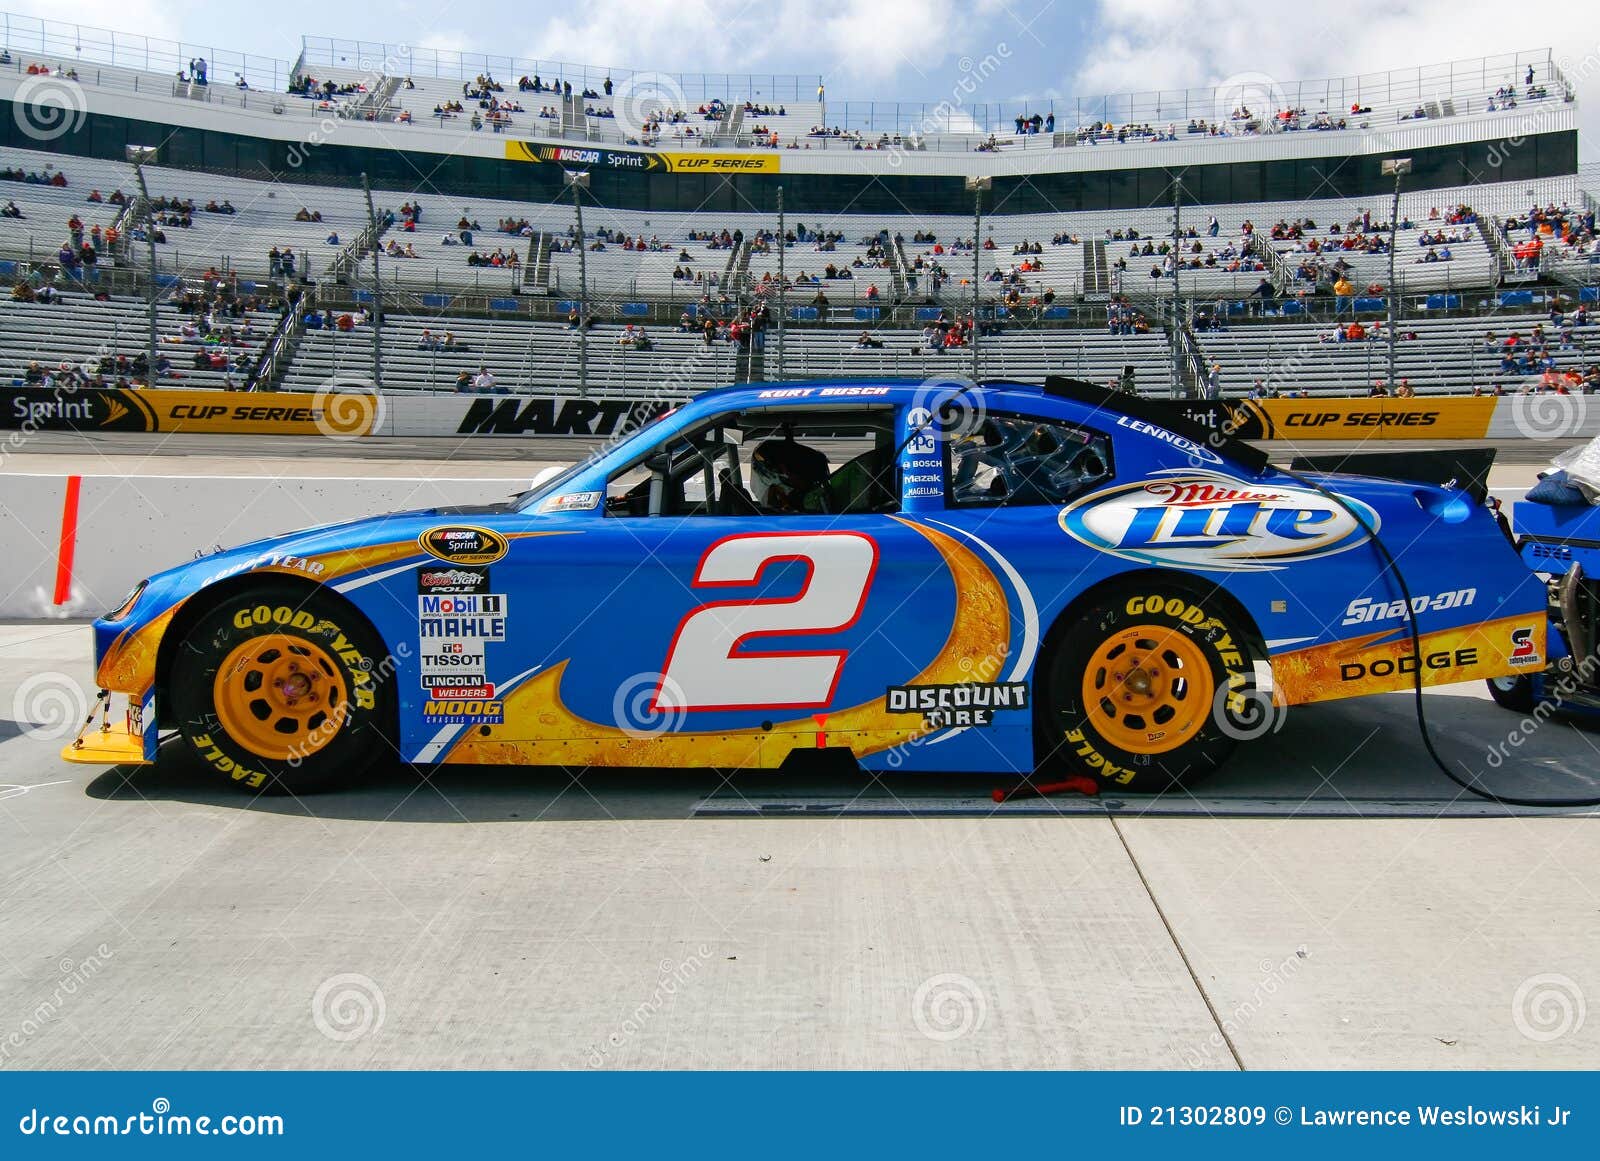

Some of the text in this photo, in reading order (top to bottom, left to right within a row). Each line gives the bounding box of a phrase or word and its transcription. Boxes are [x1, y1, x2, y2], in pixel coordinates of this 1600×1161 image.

[557, 149, 765, 168] NASCAR Sprint CUP SERIES
[758, 386, 892, 399] KURT BUSCH
[13, 396, 327, 423] Sprint CUP SERIES
[1285, 412, 1341, 427] CUP
[1343, 412, 1441, 426] SERIES
[907, 436, 934, 451] PPG
[1117, 416, 1203, 456] LENNOX
[912, 460, 943, 468] BOSCH
[904, 474, 941, 484] Mazak
[908, 487, 939, 496] MAGELLAN
[1144, 482, 1292, 504] Miller
[1111, 502, 1338, 549] Lite
[445, 531, 475, 540] NASCAR
[448, 540, 479, 551] Sprint
[452, 575, 485, 585] LIGHT
[422, 596, 477, 613] Mobil
[1341, 588, 1477, 626] Snap-on
[420, 618, 504, 637] MAHLE
[648, 530, 881, 713] 2
[233, 605, 376, 710] GOODYEAR
[422, 654, 483, 666] TISSOT
[1125, 594, 1247, 715] GOODYEAR
[1341, 648, 1478, 681] DODGE
[425, 677, 481, 686] LINCOLN
[438, 689, 487, 697] WELDERS
[889, 685, 1026, 710] DISCOUNT
[423, 701, 503, 715] MOOG
[426, 715, 499, 724] CHASSIS PARTS
[926, 709, 988, 726] TIRE
[192, 733, 268, 788] EAGLE
[1065, 728, 1137, 785] EAGLE
